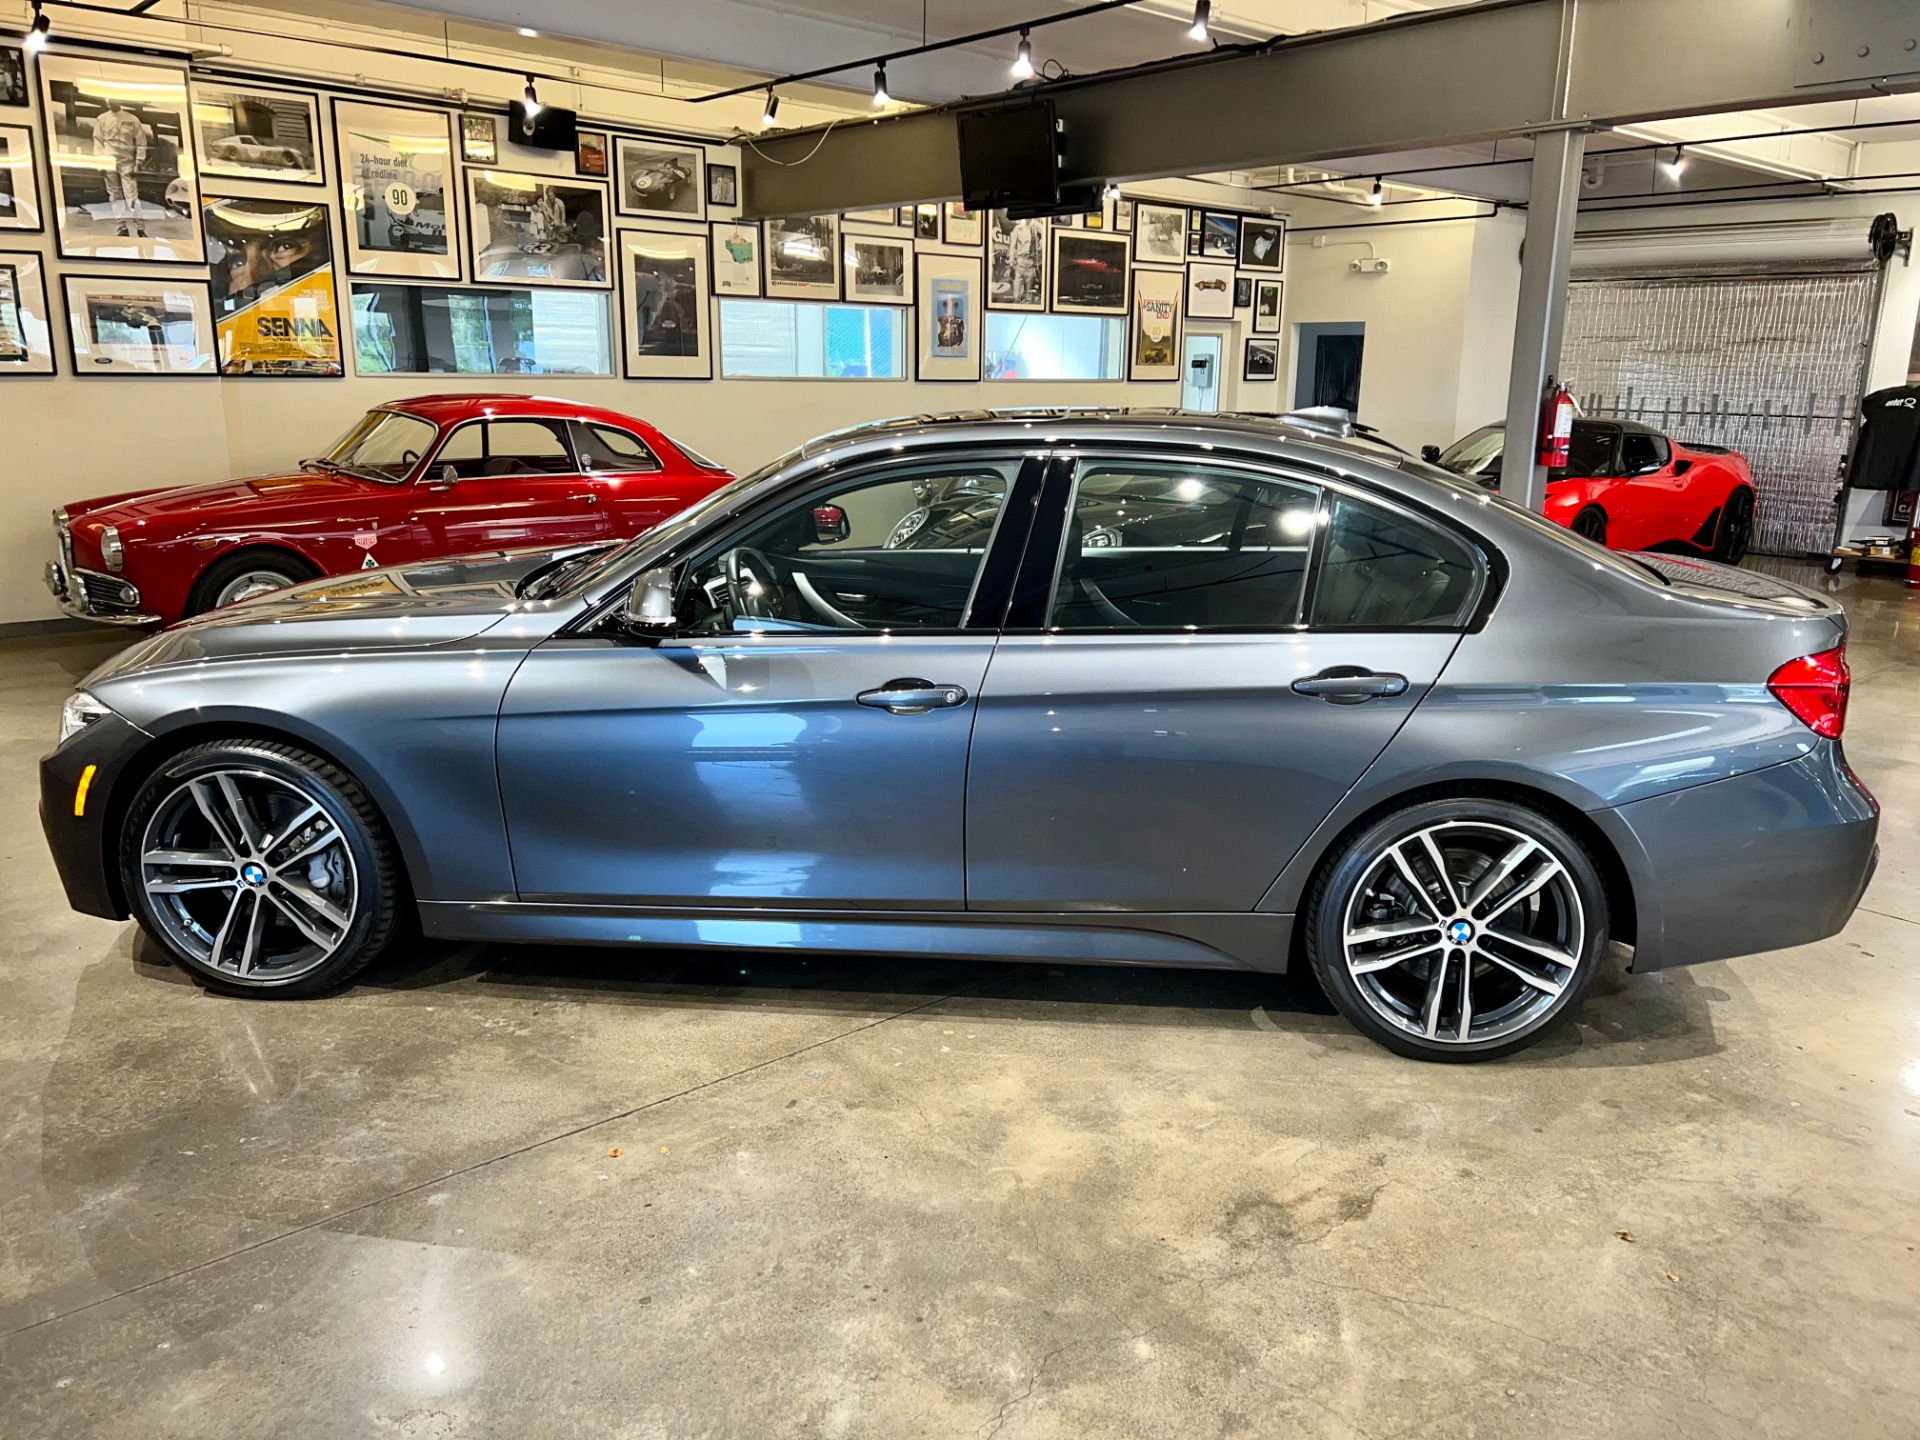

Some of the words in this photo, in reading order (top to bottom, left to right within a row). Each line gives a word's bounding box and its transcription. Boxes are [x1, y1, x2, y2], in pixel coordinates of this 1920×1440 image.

[360, 152, 391, 166] 24-hour
[393, 156, 408, 168] diet
[371, 168, 398, 180] redline
[392, 188, 408, 206] 90
[1146, 302, 1173, 313] SANITY
[1156, 311, 1170, 319] END
[257, 316, 334, 338] SENNA
